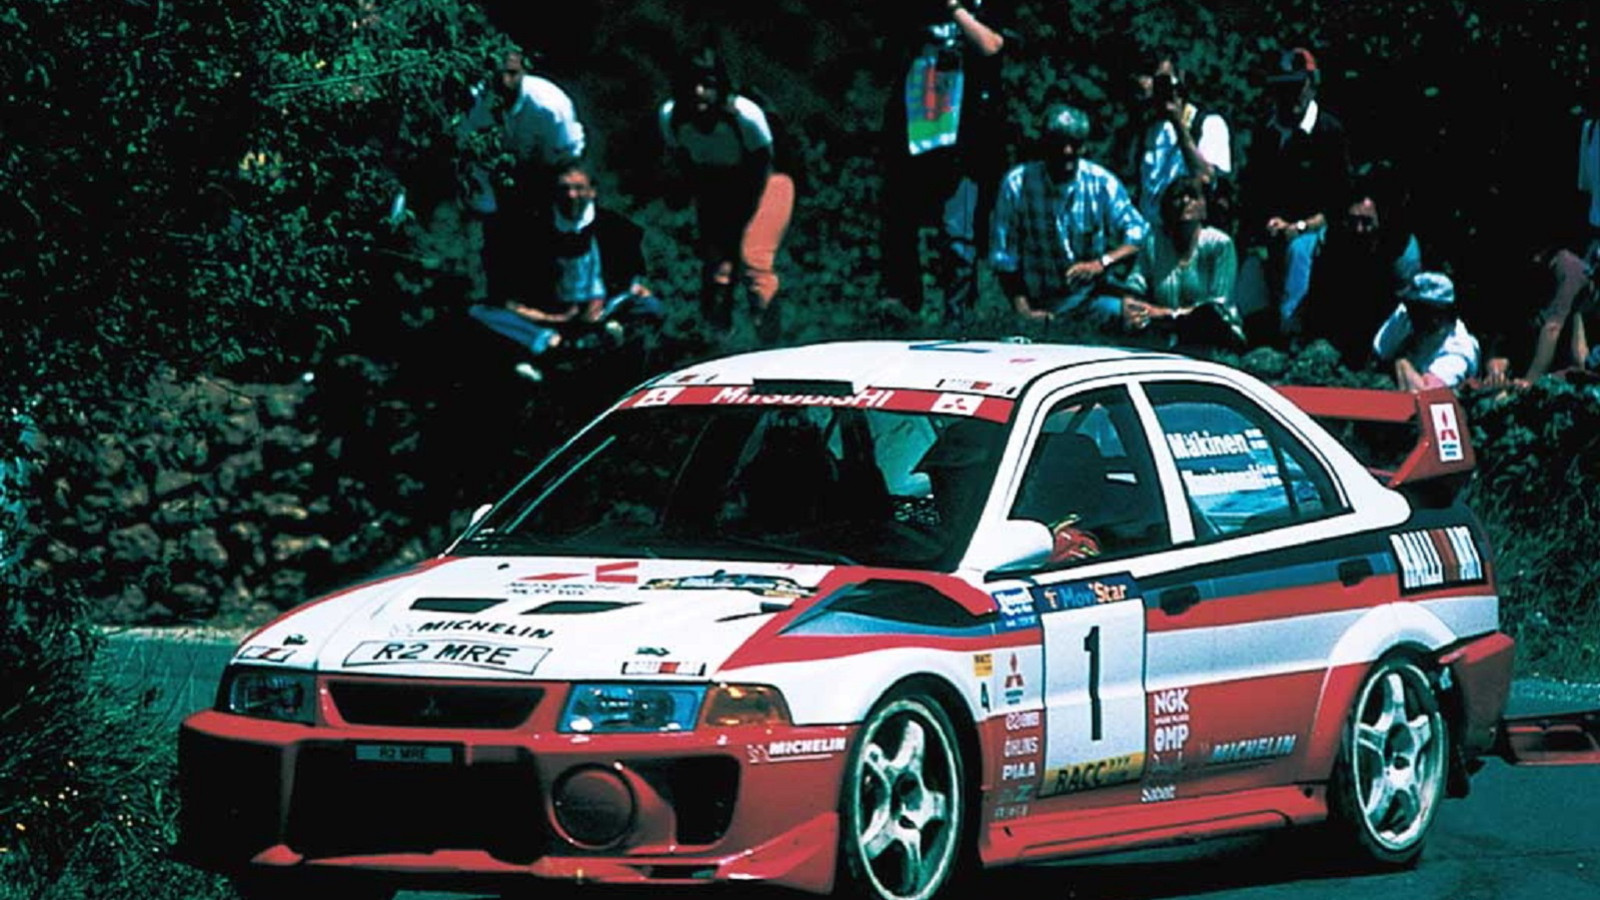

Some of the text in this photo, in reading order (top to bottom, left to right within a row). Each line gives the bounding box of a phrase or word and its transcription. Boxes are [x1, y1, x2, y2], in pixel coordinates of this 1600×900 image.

[1166, 430, 1249, 460] Mäkinen
[417, 619, 554, 639] MICHELIN
[372, 642, 519, 666] R2 MRE
[1083, 625, 1102, 741] 1
[1154, 689, 1190, 715] NGK
[769, 737, 847, 756] MICHELIN
[1153, 724, 1190, 753] OMP
[1212, 734, 1297, 764] MICHELIN
[1055, 760, 1109, 795] RACC
